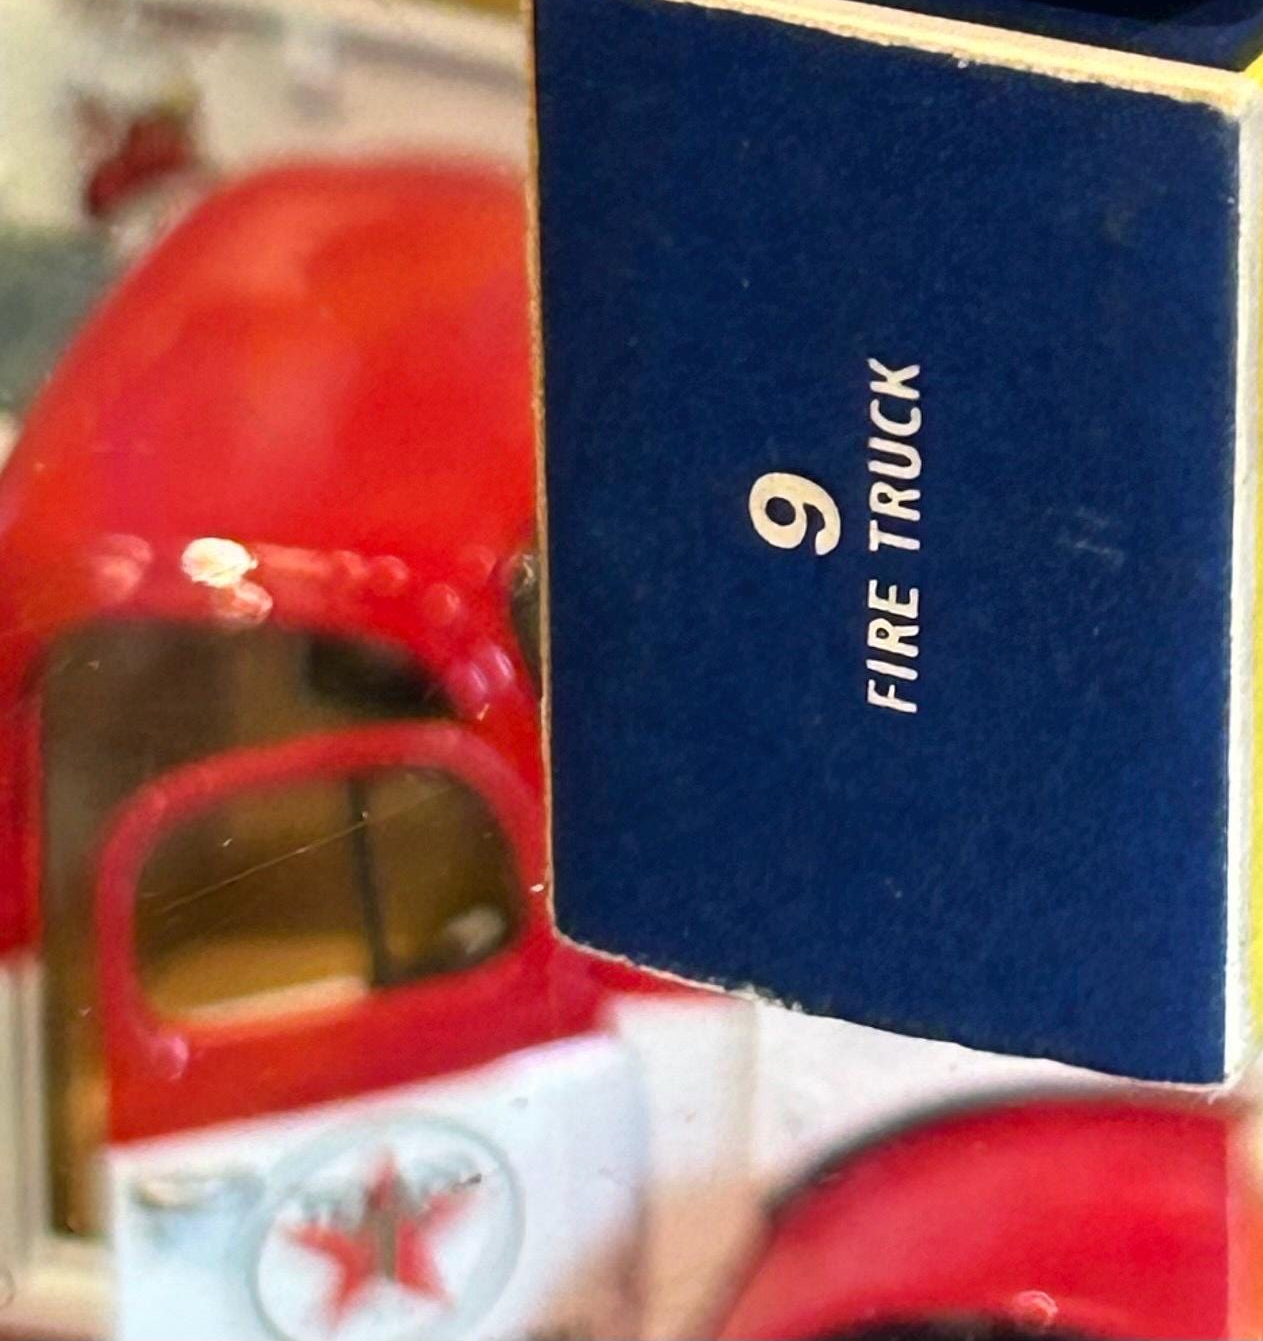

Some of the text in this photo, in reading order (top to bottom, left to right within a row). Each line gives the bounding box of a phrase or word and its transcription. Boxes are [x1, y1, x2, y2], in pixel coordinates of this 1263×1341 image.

[748, 470, 841, 556] 9
[866, 357, 922, 714] FIRE TRUCK
